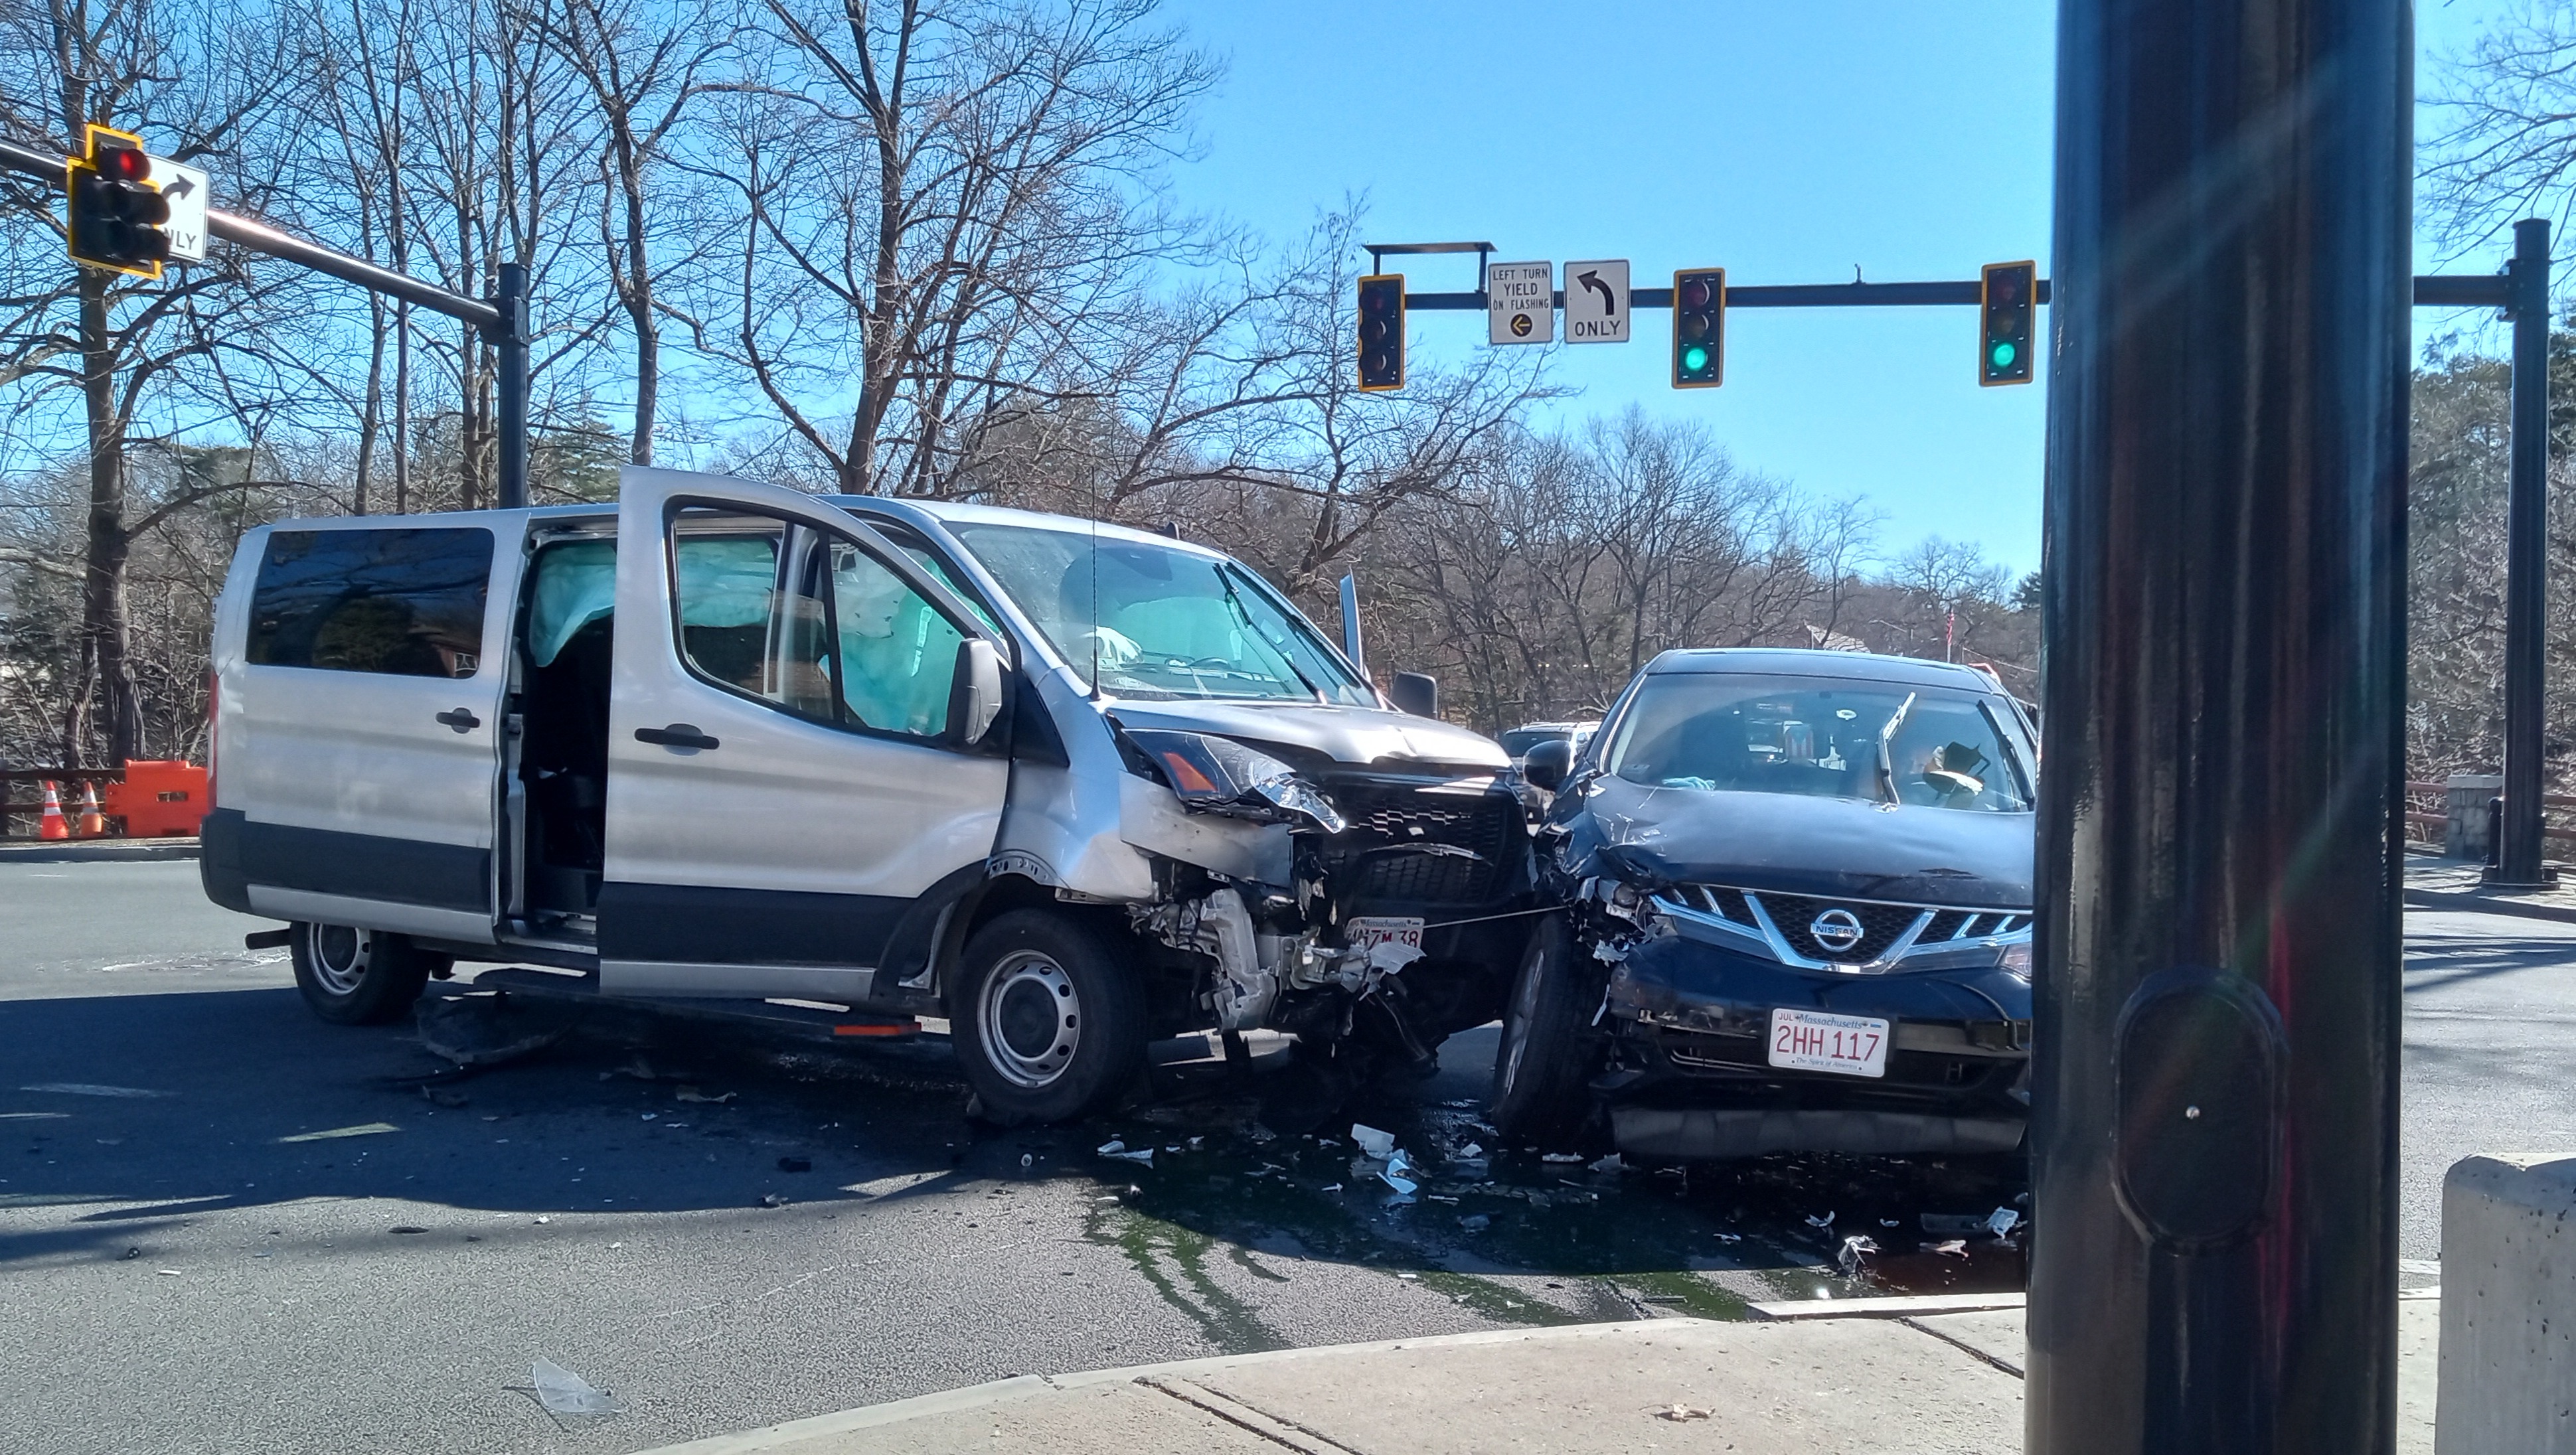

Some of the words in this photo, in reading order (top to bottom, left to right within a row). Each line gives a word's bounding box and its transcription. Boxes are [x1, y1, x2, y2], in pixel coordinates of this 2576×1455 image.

[164, 227, 197, 250] NLY
[1493, 269, 1516, 281] LEFT
[1523, 268, 1548, 279] TURN
[1504, 282, 1538, 297] YIELD
[1493, 300, 1504, 311] ON
[1510, 298, 1549, 311] FLASHING
[1575, 320, 1621, 337] ONLY
[1816, 925, 1858, 937] NISSAN
[1779, 1013, 1793, 1022] JUL
[1799, 1014, 1863, 1030] Massachusetts
[1777, 1025, 1824, 1056] 2HH
[1831, 1030, 1880, 1061] 117
